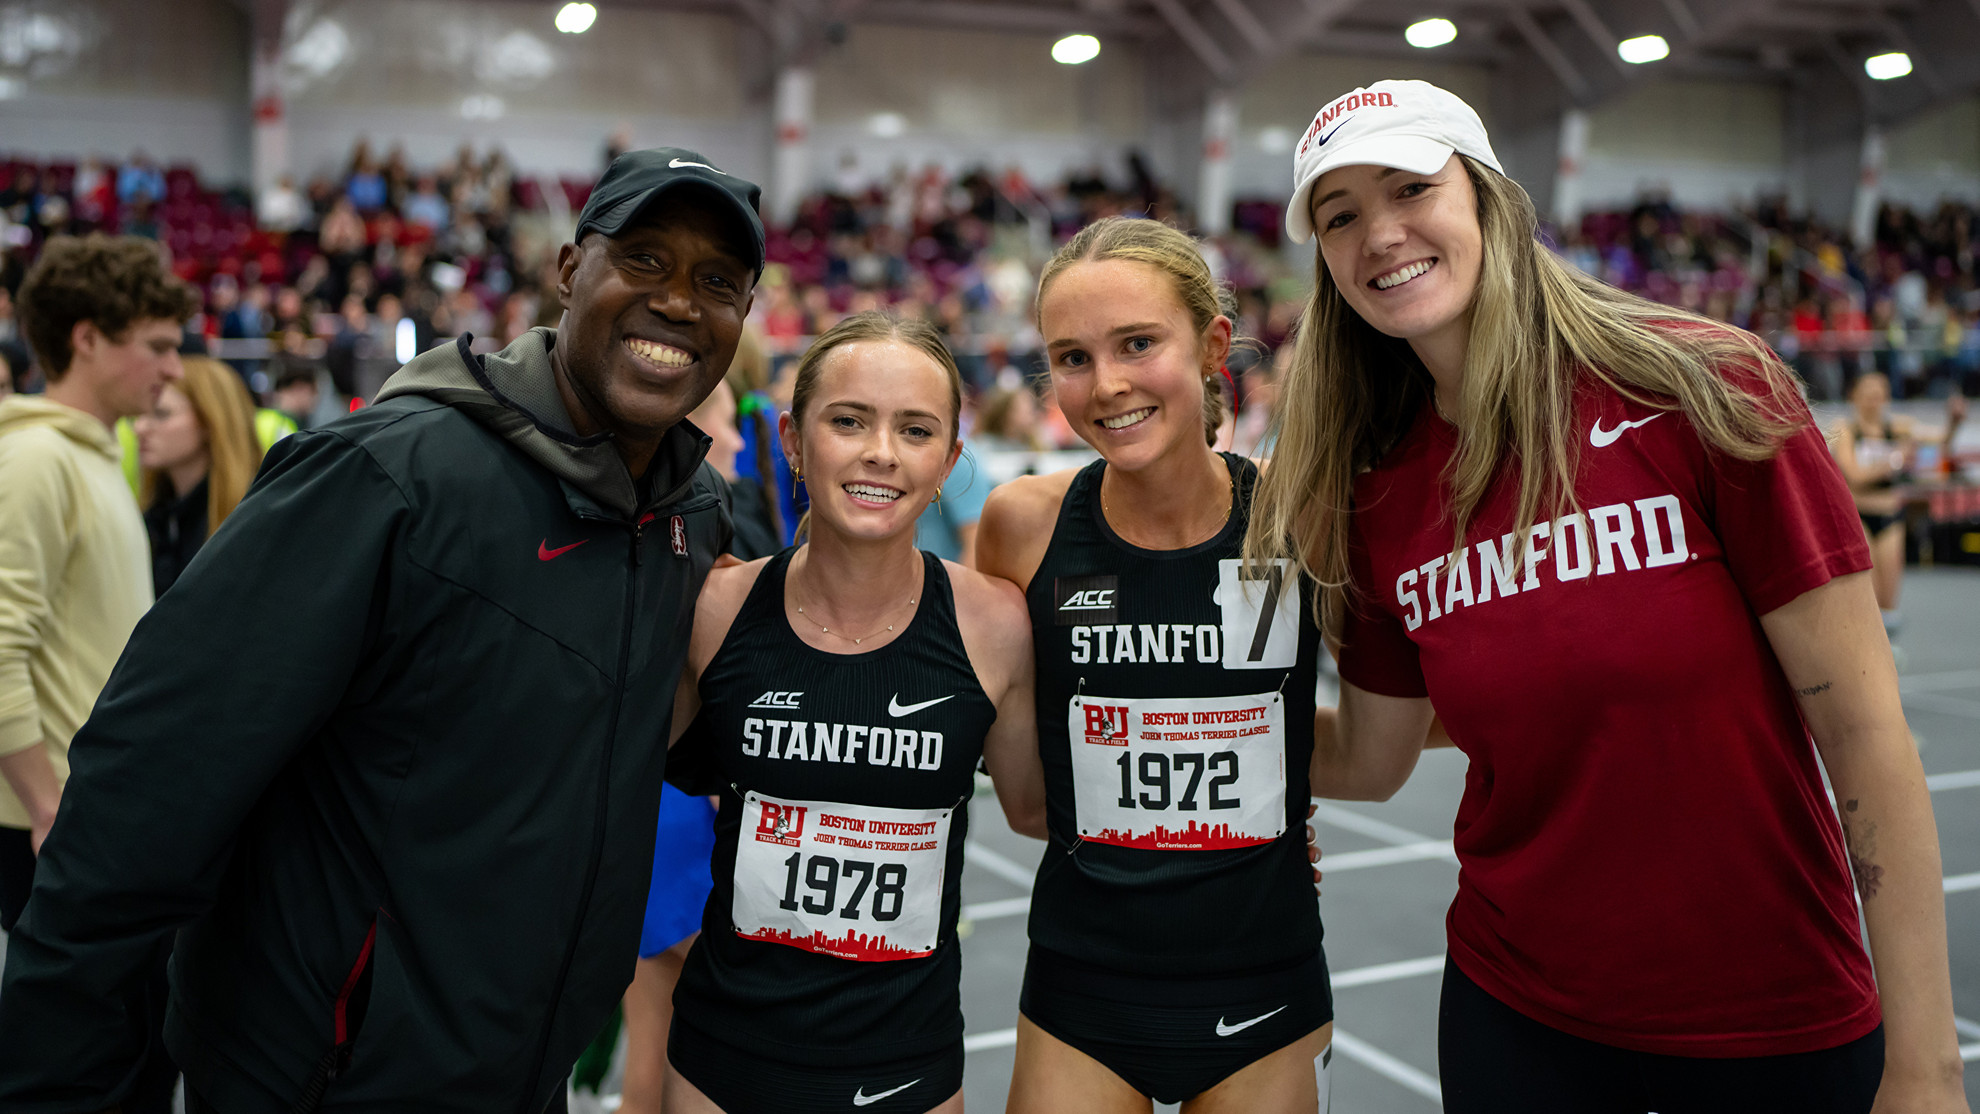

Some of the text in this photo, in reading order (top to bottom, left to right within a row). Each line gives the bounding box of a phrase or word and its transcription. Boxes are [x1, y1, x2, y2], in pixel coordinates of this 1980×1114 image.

[1396, 494, 1690, 632] STANFORD
[1063, 590, 1116, 606] ACC
[1237, 565, 1283, 663] 7
[1071, 624, 1223, 664] STANFO
[752, 691, 805, 706] ACC
[1083, 704, 1129, 739] BU
[1142, 706, 1267, 726] BOSTON UNIVERSITY
[742, 717, 944, 771] STANFORD
[1088, 737, 1105, 745] TRACK
[1140, 725, 1270, 742] JOHN THOMAS TERRIER CLASSIC
[1116, 750, 1241, 811] 1972
[756, 800, 808, 839] BU
[819, 813, 937, 836] BOSTON UNIVERSITY
[759, 835, 777, 843] TRACK
[782, 839, 798, 847] FIELD
[813, 833, 938, 851] JOHN THOMAS TERRIER CLASSIC
[779, 851, 908, 922] 1978
[813, 945, 858, 959] GoTerriers.com
